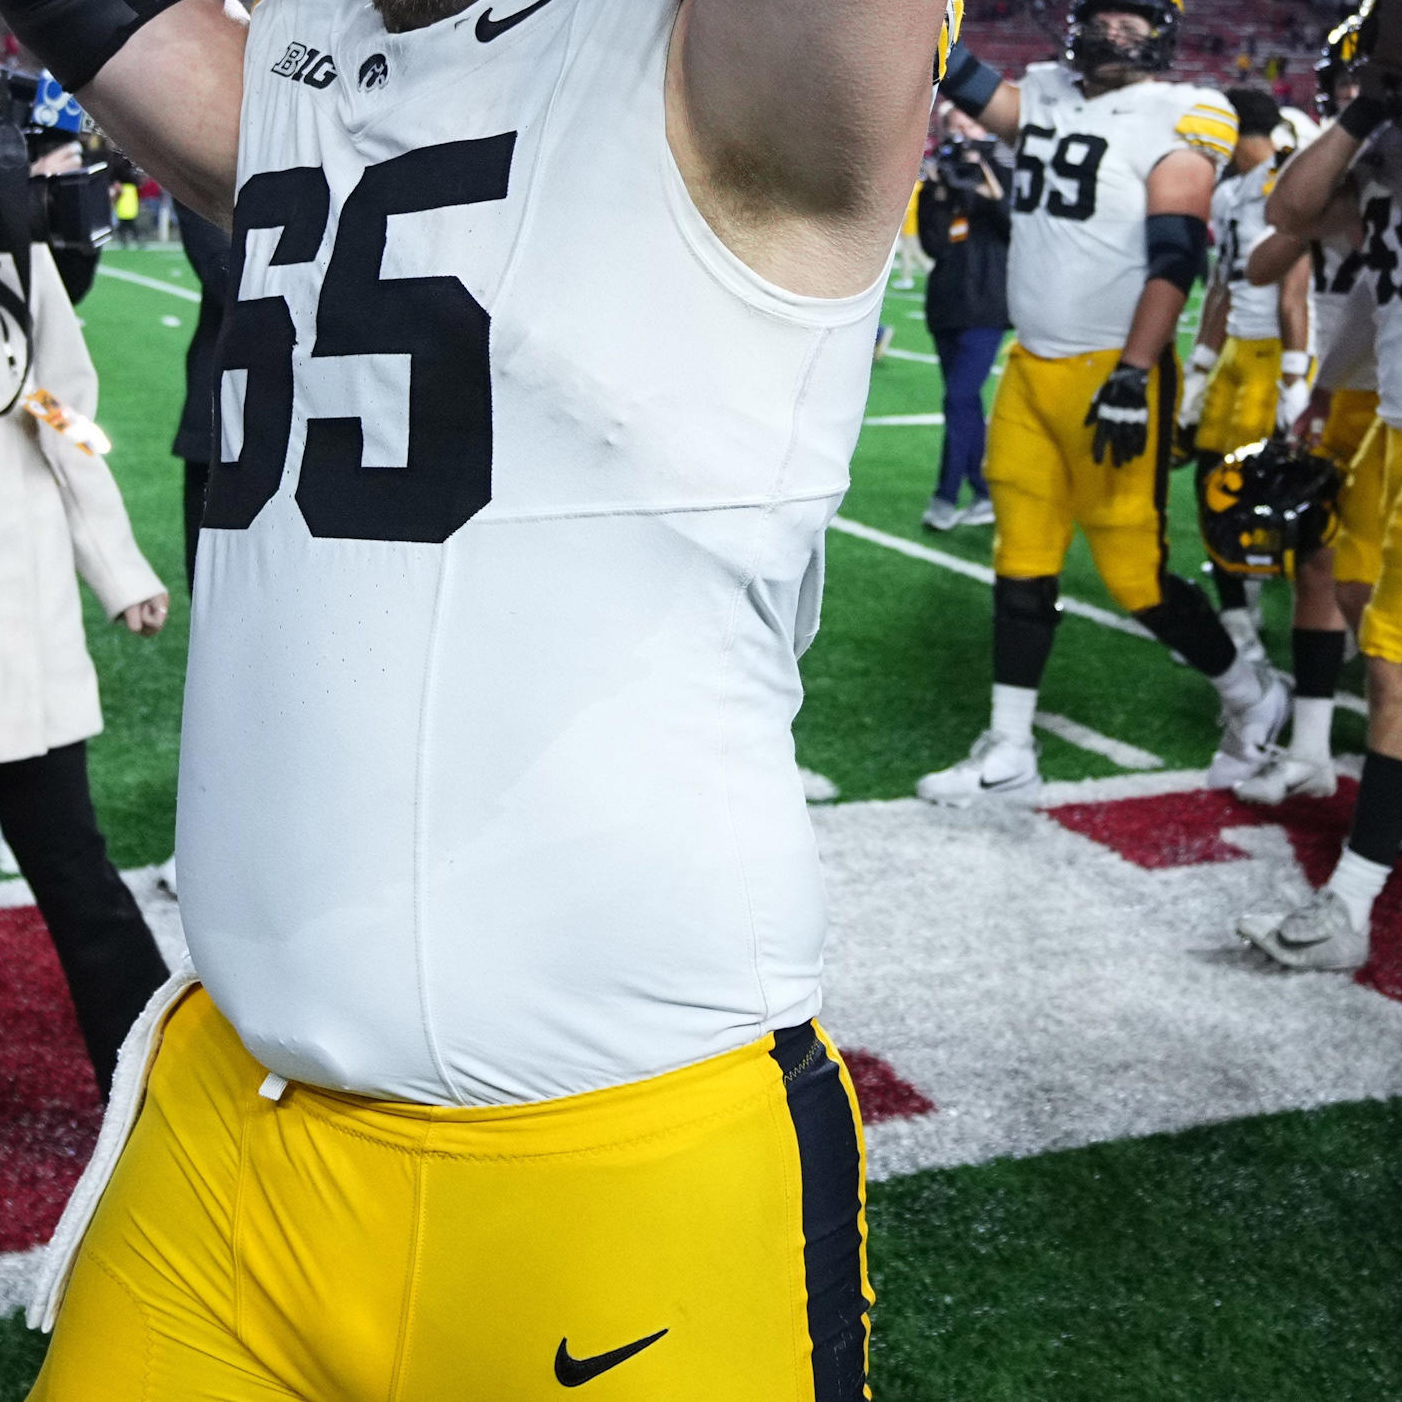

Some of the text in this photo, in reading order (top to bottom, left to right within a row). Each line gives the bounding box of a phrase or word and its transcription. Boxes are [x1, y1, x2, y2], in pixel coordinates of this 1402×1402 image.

[271, 41, 338, 90] BIG
[1014, 124, 1109, 221] 59
[199, 131, 517, 543] 65
